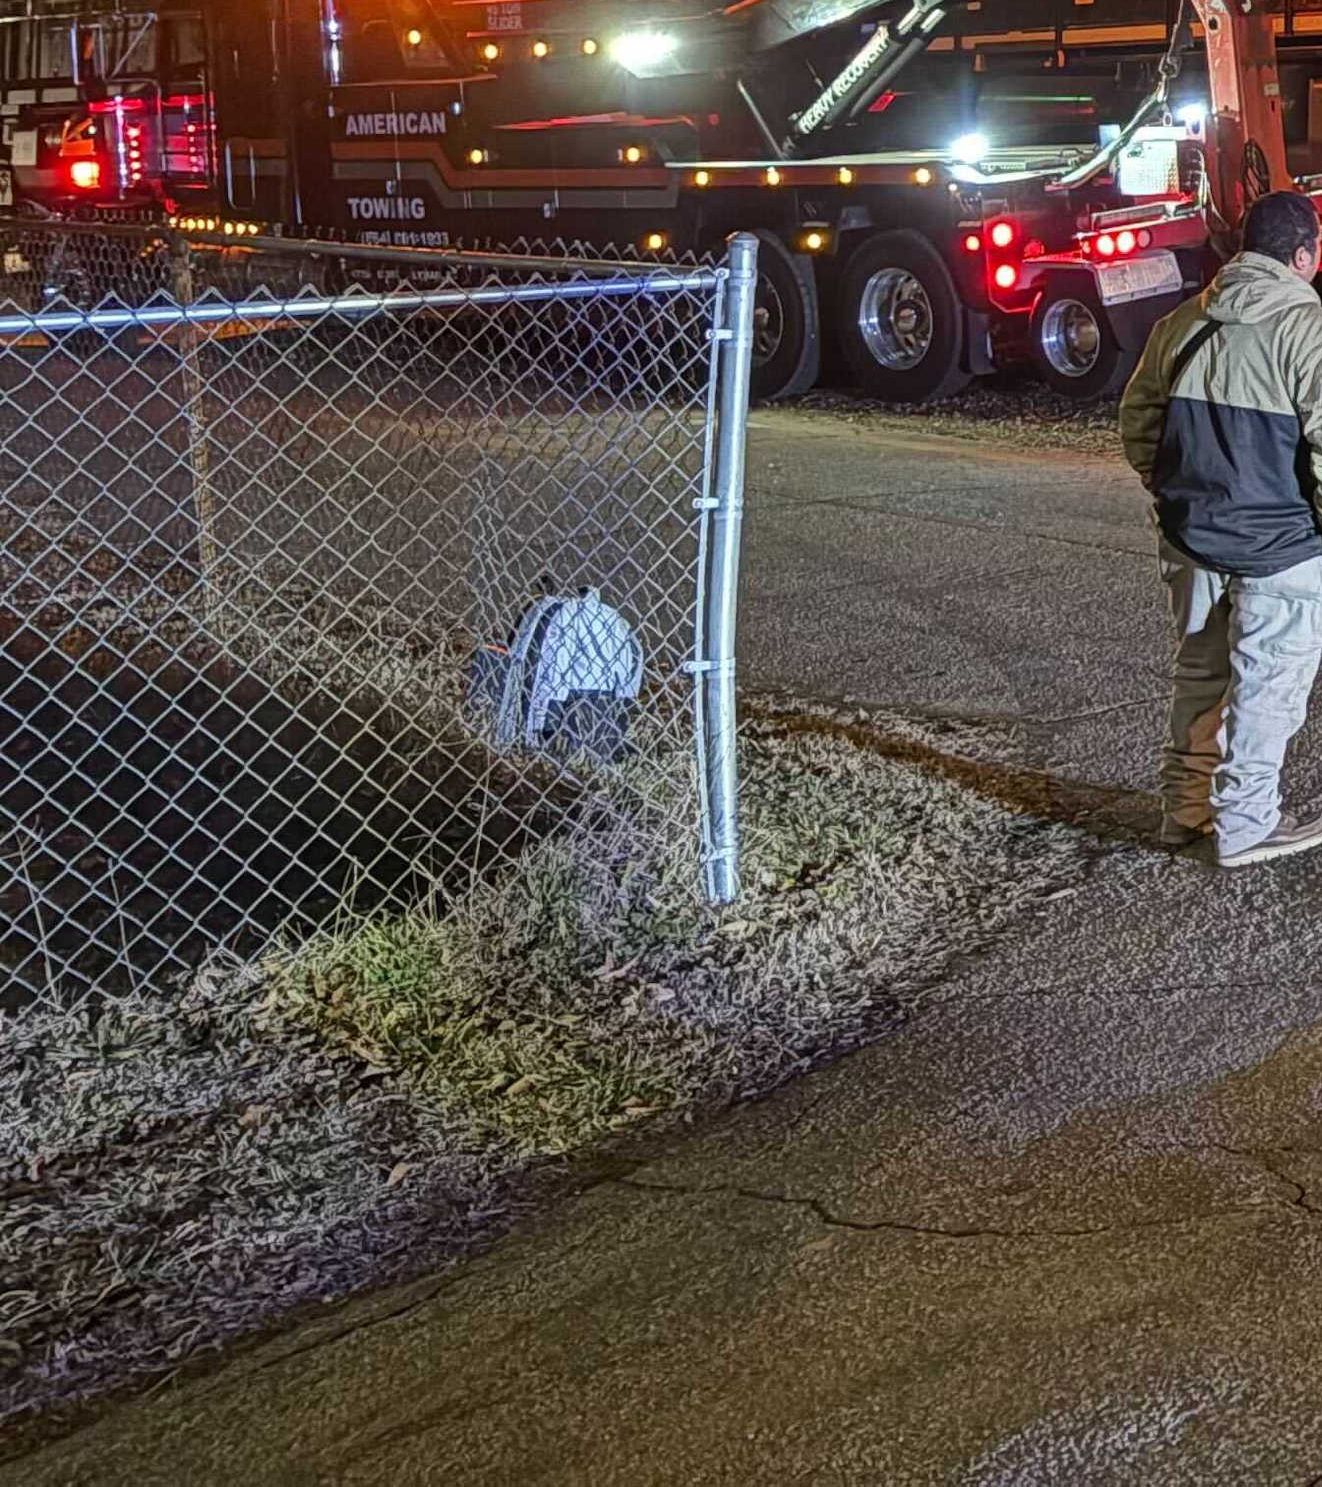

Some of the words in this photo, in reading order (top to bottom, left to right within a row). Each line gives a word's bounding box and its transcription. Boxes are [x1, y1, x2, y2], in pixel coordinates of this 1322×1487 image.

[798, 86, 835, 134] HEAVY
[346, 111, 447, 135] AMERICAN
[347, 197, 425, 219] TOWING
